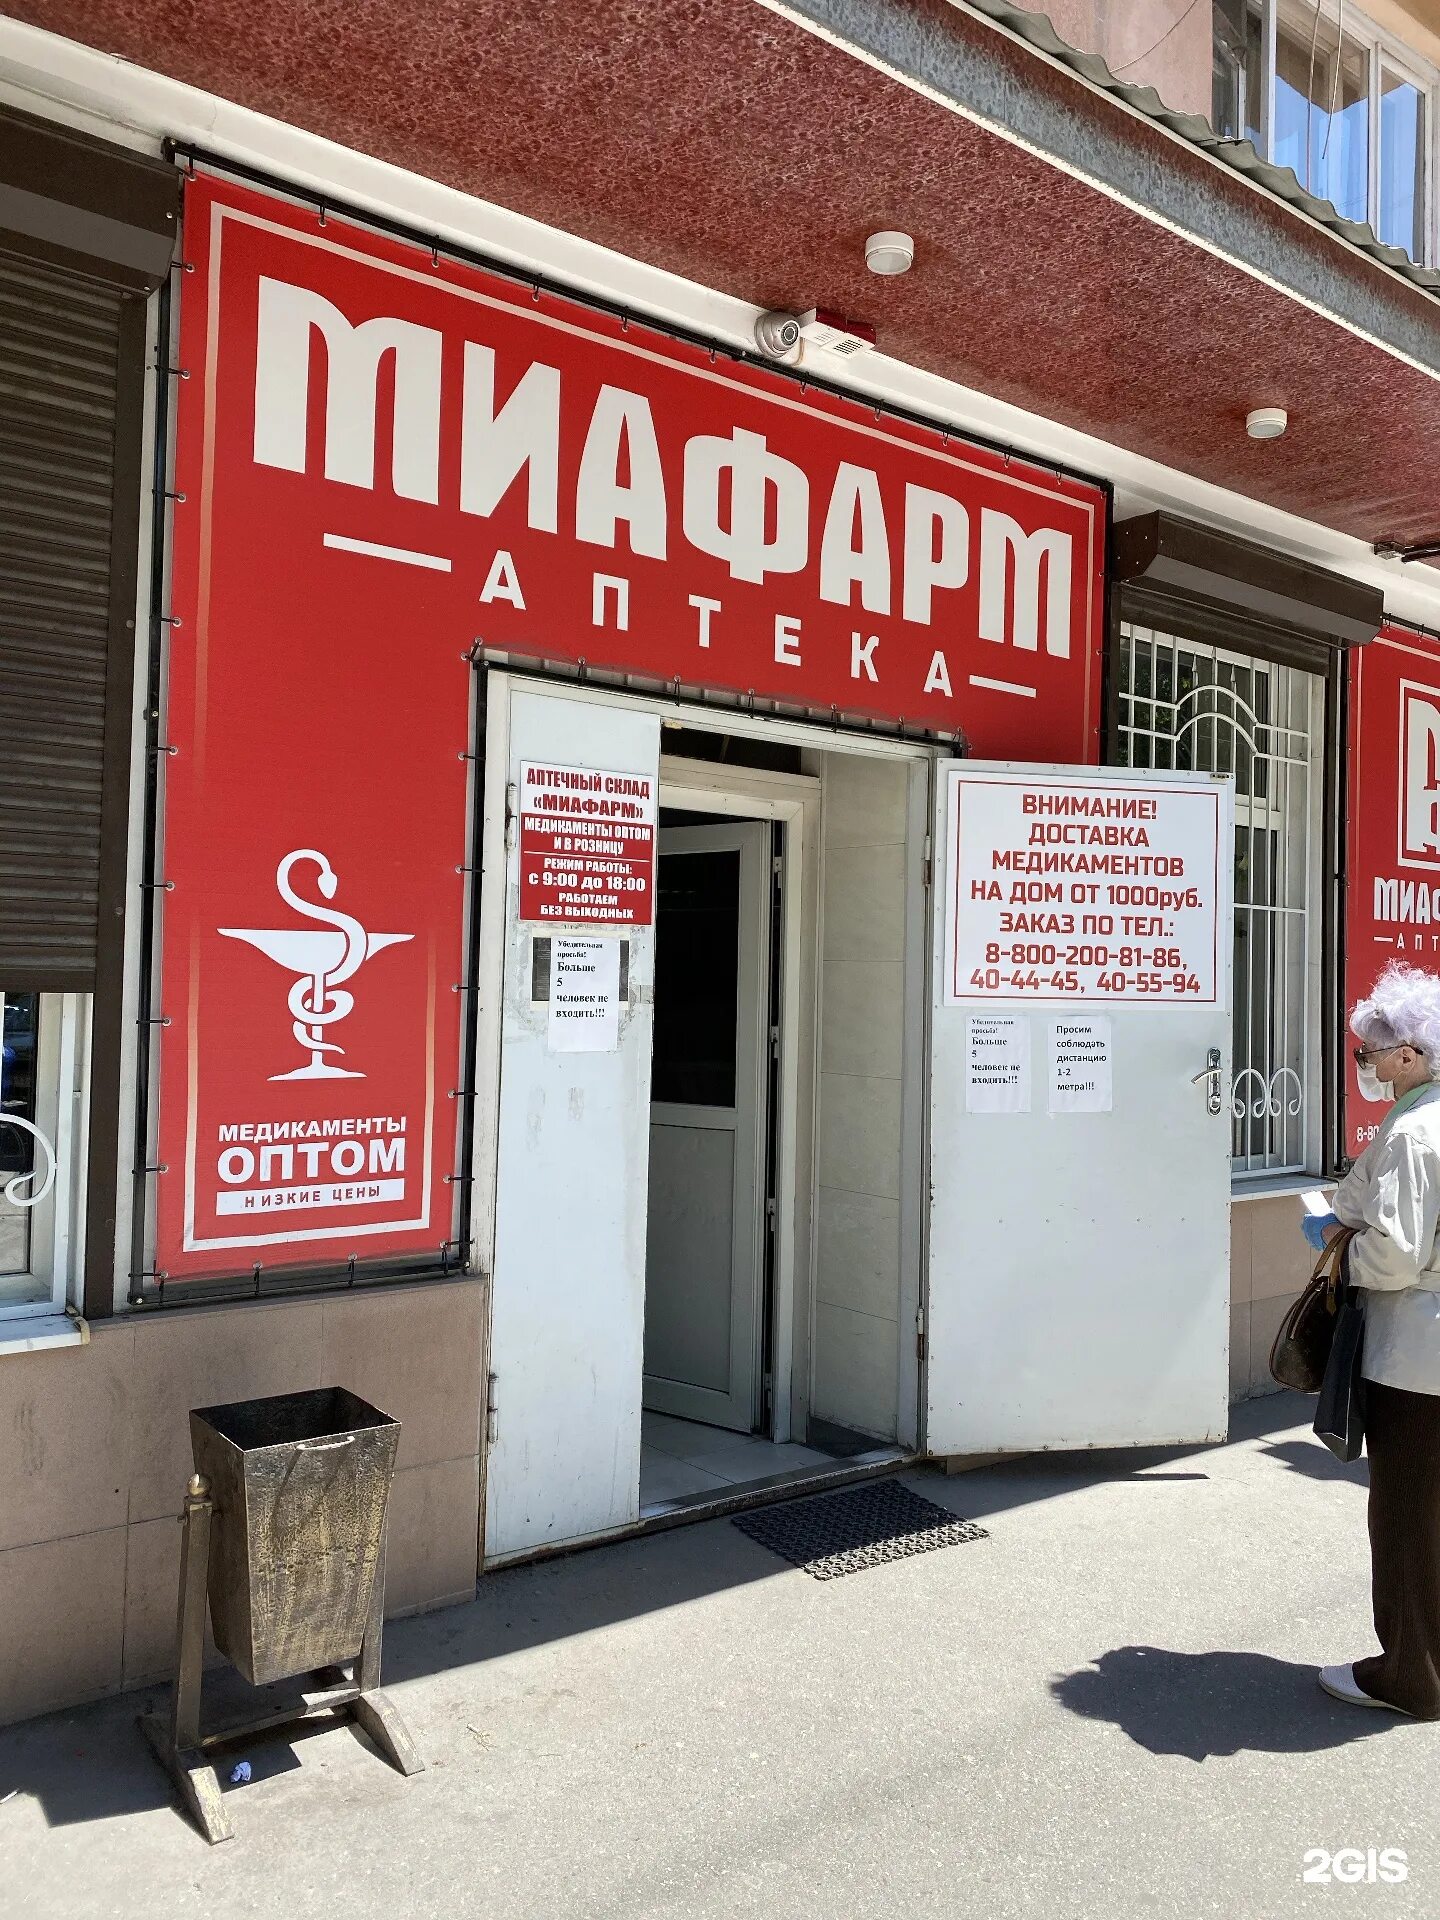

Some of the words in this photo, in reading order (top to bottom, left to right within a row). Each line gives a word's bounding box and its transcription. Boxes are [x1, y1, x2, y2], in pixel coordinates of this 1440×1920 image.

[253, 275, 1073, 659] МИАФАРМ
[479, 550, 953, 698] АПТЕКА
[527, 768, 602, 792] АПТЕЧНЫЙ
[605, 777, 650, 800] СКЛАД
[534, 794, 644, 819] «МИАФАРМ»
[1022, 794, 1157, 820] ВНИМАНИЕ!
[524, 816, 612, 837] МЕДИКАМЕНТЫ
[615, 825, 651, 841] ОПТОМ
[1028, 823, 1149, 847] ДОСТАВКА
[554, 836, 562, 850] И
[564, 837, 572, 851] В
[574, 838, 624, 856] РОЗНИЦУ
[544, 857, 584, 872] РЕЖИМ
[586, 860, 633, 875] РАБОТЫ:
[992, 850, 1184, 877] МЕДИКАМЕНТОВ
[528, 873, 539, 885] с
[542, 872, 578, 887] 9:00
[581, 876, 603, 890] до
[606, 876, 646, 892] 18:00
[558, 892, 618, 905] РАБОТАЕМ
[971, 880, 1003, 901] НА
[1009, 882, 1063, 905] ДОМ
[1070, 883, 1101, 904] ОТ
[1107, 885, 1203, 912] 1000руб.
[540, 905, 562, 916] БЕЗ
[565, 906, 634, 919] ВЫХОДНЫХ
[999, 912, 1075, 934] ЗАКАЗ
[1082, 915, 1113, 935] ПО
[1120, 916, 1174, 937] ТЕЛ.:
[557, 962, 596, 972] Больше
[985, 943, 1187, 971] 8-800-200-81-86,
[556, 977, 563, 987] 5
[970, 969, 1085, 994] 40-44-45,
[1096, 972, 1200, 994] 40-55-94
[556, 995, 595, 1003] человек
[598, 995, 609, 1003] не
[555, 1008, 605, 1018] входить!!!
[1056, 1025, 1092, 1035] Просим
[972, 1037, 1007, 1046] Больше
[1056, 1039, 1106, 1049] соблюдать
[971, 1049, 977, 1058] 5
[1056, 1054, 1107, 1063] дистанцию
[971, 1075, 1018, 1085] входить!!!
[1057, 1068, 1071, 1076] 1-2
[1057, 1081, 1095, 1092] метра!!!
[218, 1116, 407, 1144] МЕДИКАМЕНТЫ
[217, 1137, 406, 1184] ОПТОМ
[244, 1190, 321, 1208] НИЗКИЕ
[332, 1185, 380, 1201] ЦЕНЫ
